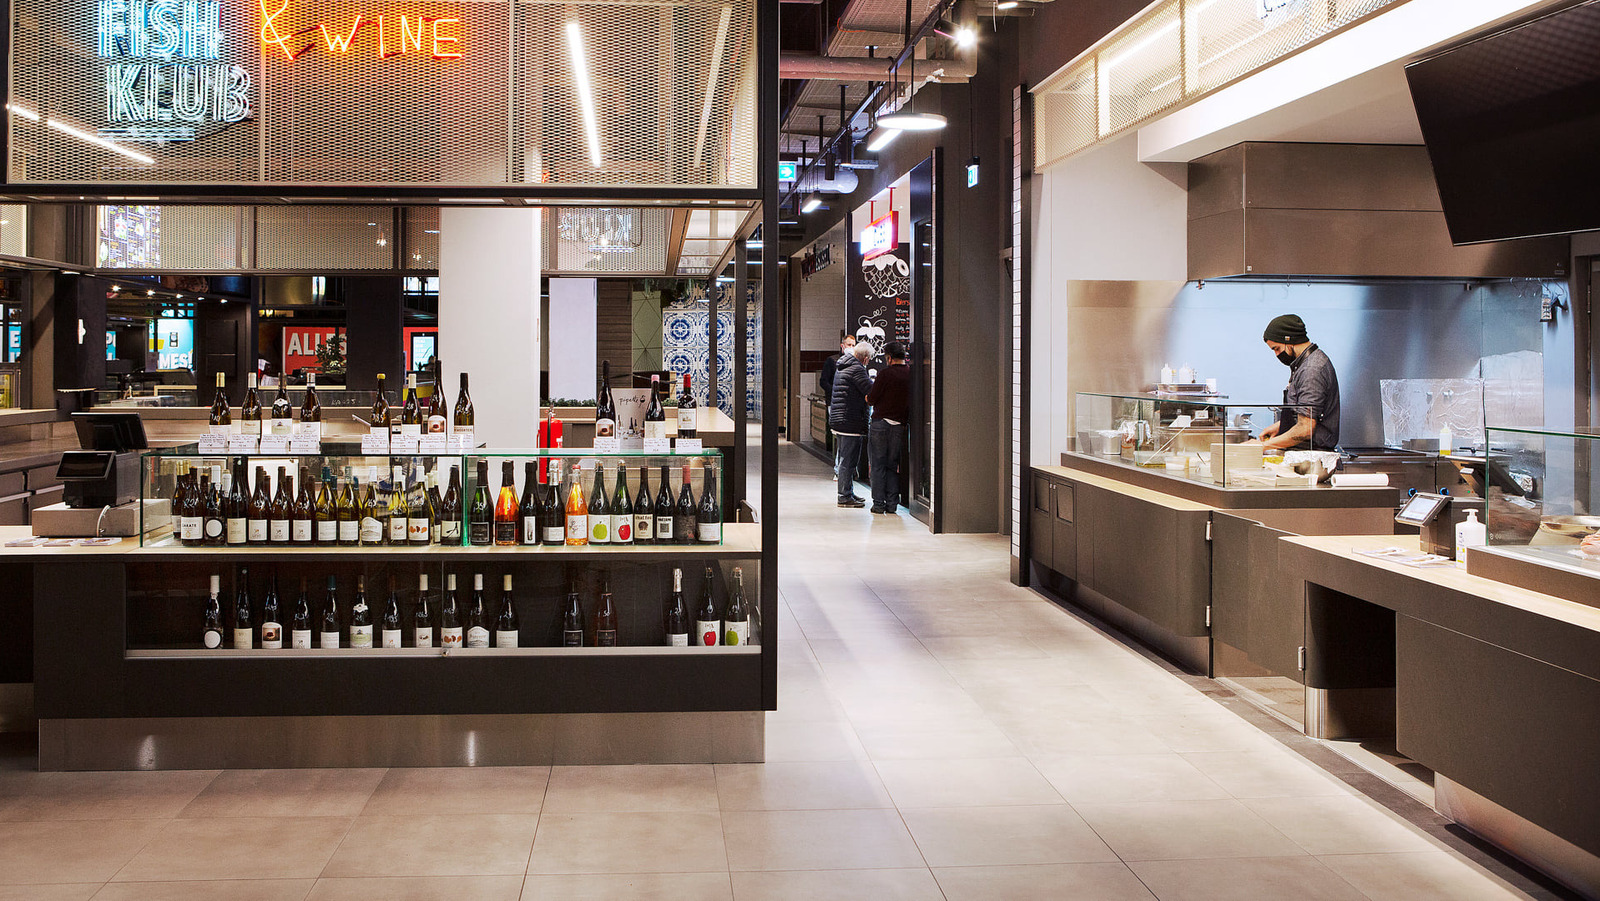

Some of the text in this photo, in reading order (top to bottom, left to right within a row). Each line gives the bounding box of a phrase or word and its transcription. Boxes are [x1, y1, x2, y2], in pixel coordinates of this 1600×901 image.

[98, 0, 222, 58] FISH
[319, 15, 463, 58] WINE
[106, 64, 251, 121] KLUB
